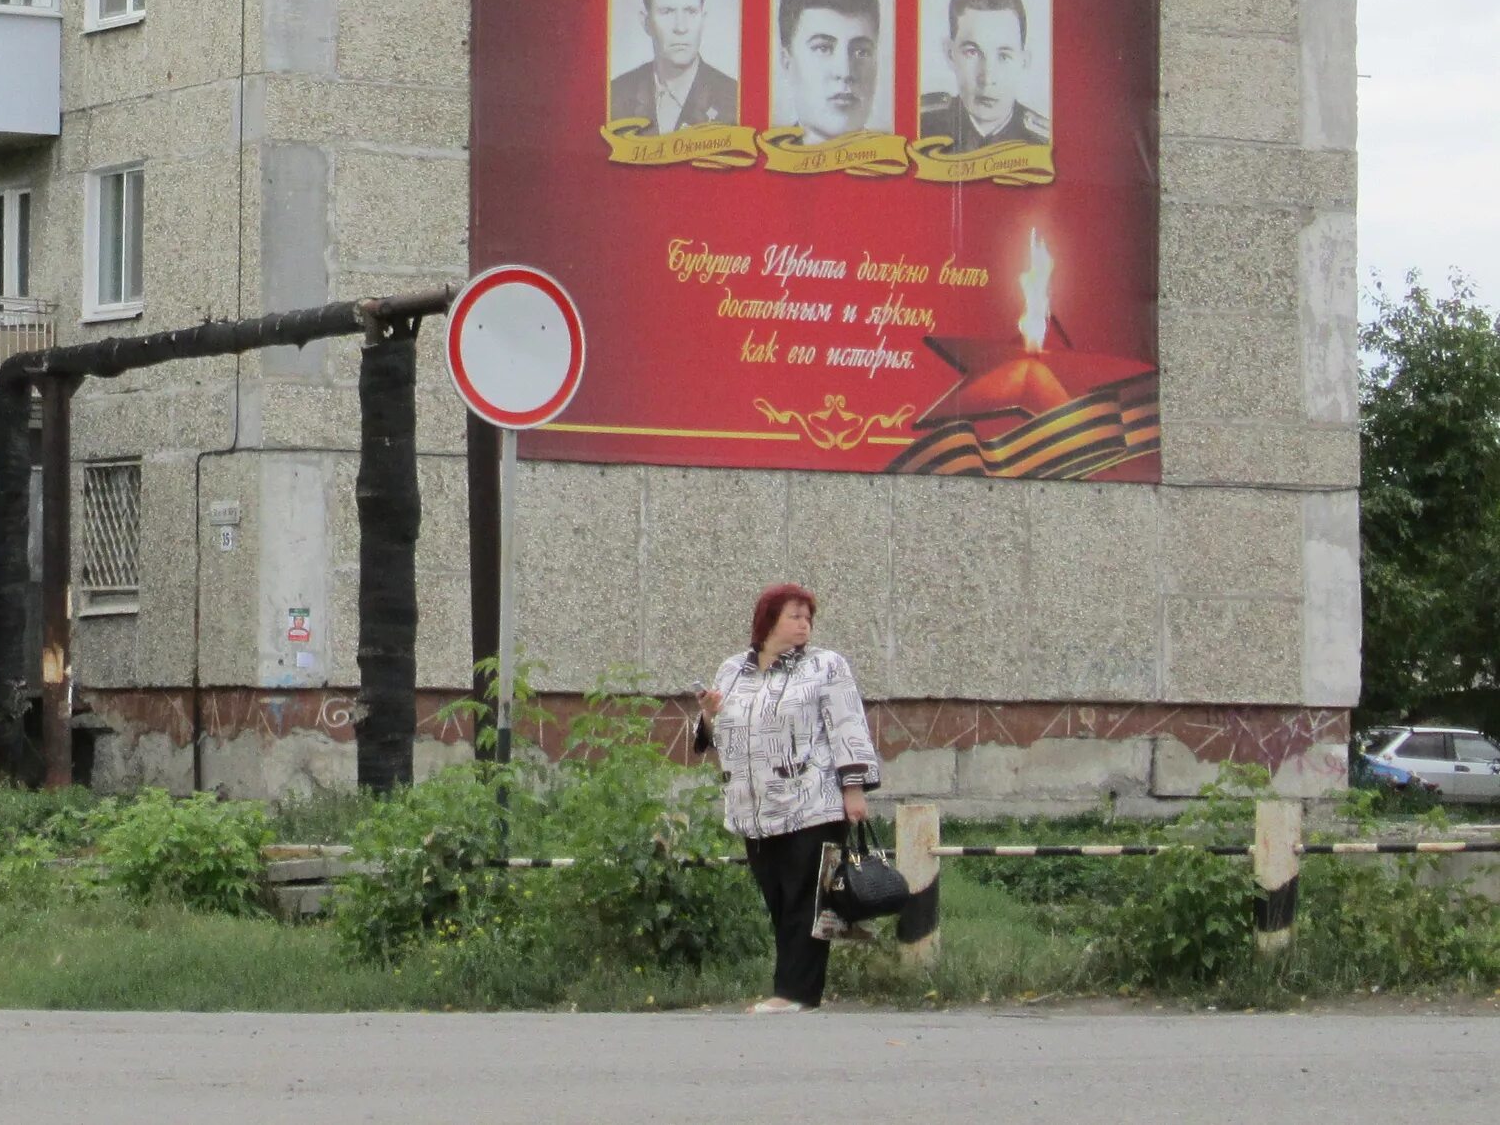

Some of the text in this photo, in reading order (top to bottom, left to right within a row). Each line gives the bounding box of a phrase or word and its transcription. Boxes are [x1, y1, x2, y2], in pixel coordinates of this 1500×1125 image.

[667, 238, 989, 289] Будущее Ирбита должно быть
[718, 287, 937, 336] достойным и ярким,
[740, 330, 915, 379] как его история.
